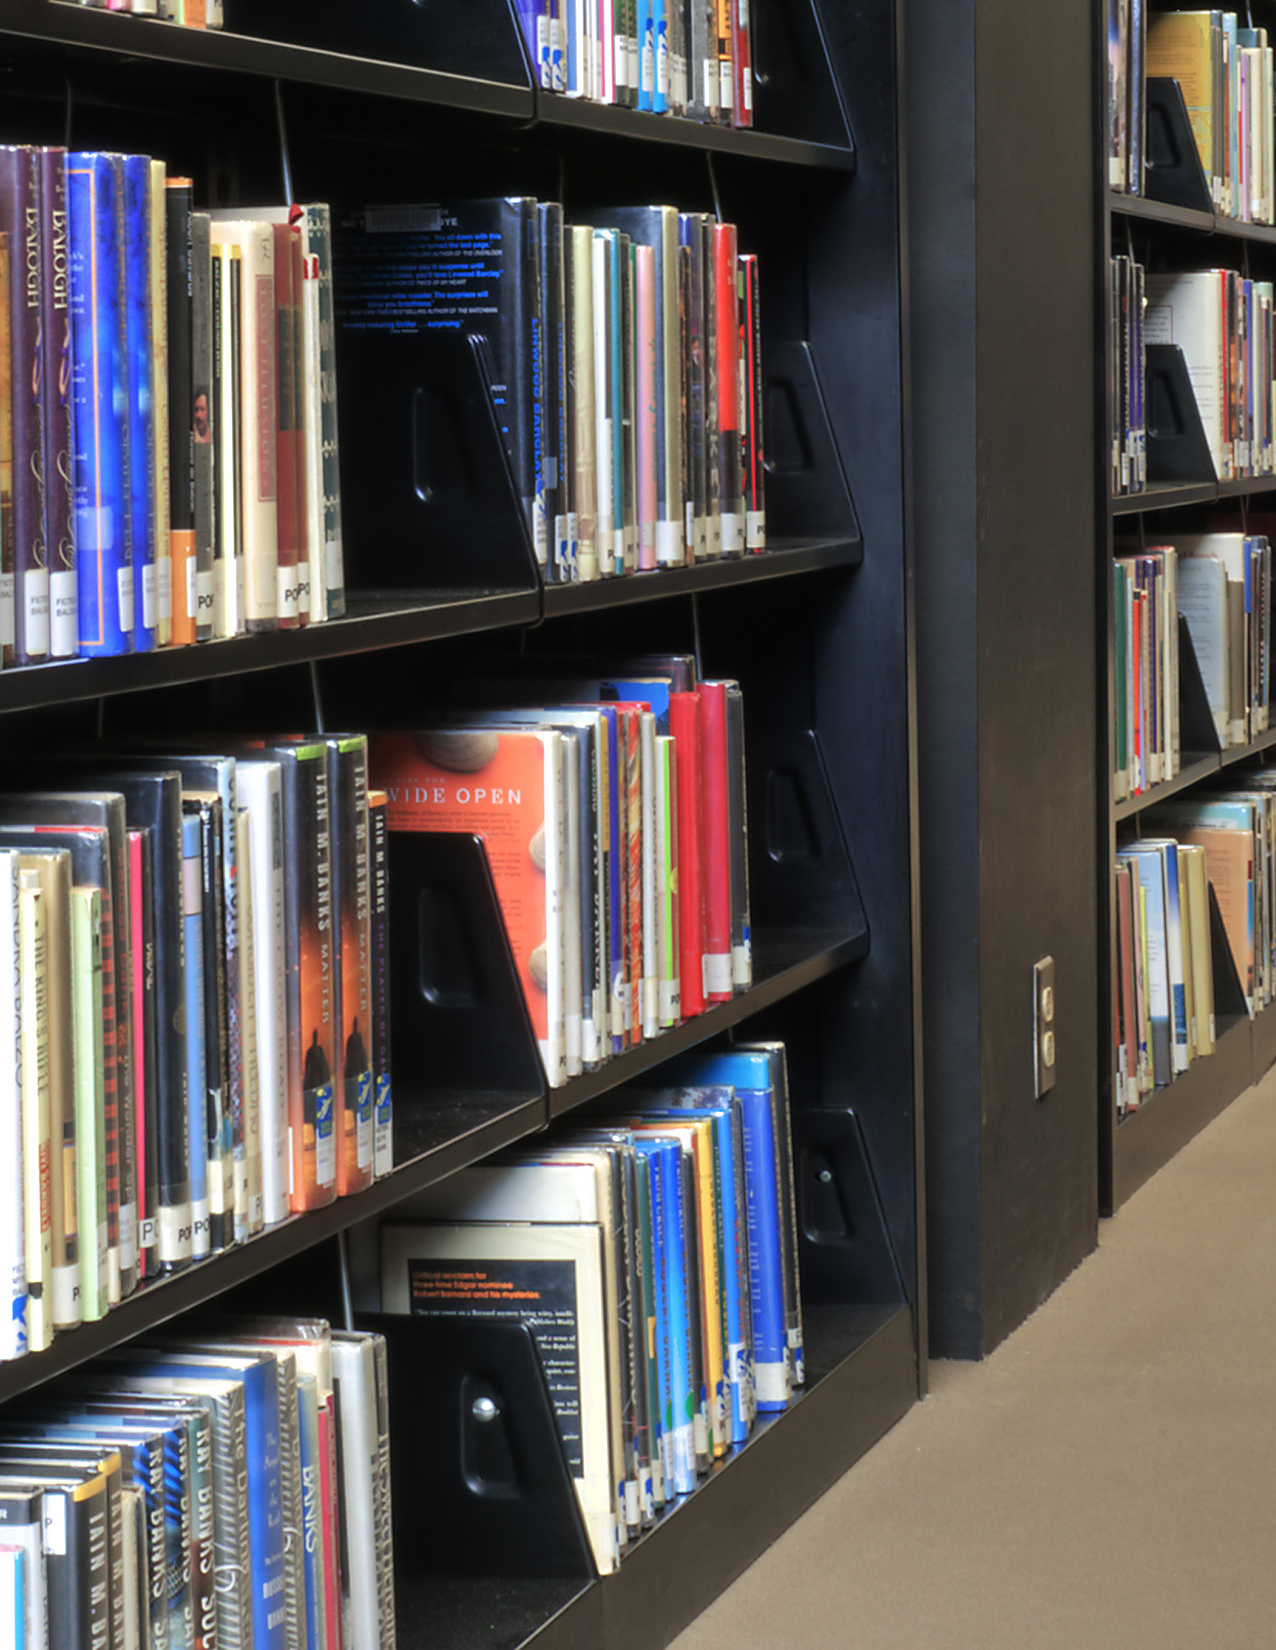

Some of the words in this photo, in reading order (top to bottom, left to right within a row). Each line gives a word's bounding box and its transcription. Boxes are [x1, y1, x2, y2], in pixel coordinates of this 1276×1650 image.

[25, 208, 39, 308] BALOGH
[52, 210, 68, 310] BALOGH
[531, 317, 540, 398] LINWOOD
[316, 773, 329, 821] IAIN
[354, 765, 367, 812] IAIN
[455, 787, 522, 805] OPEN
[317, 831, 330, 857] M.
[375, 814, 385, 845] IAIN
[317, 861, 331, 931] BANKS
[355, 853, 369, 920] BANKS
[376, 869, 387, 914] BANKS
[321, 942, 331, 1024] MATTER
[359, 933, 369, 1012] MATTER
[477, 1281, 514, 1289] nominee
[149, 1445, 164, 1494] KAY
[196, 1426, 211, 1474] KAY
[198, 1485, 216, 1576] BANKS
[302, 1464, 320, 1555] BANKS
[90, 1510, 107, 1572] IAIN
[151, 1506, 167, 1599] BANKS
[91, 1580, 108, 1616] M.
